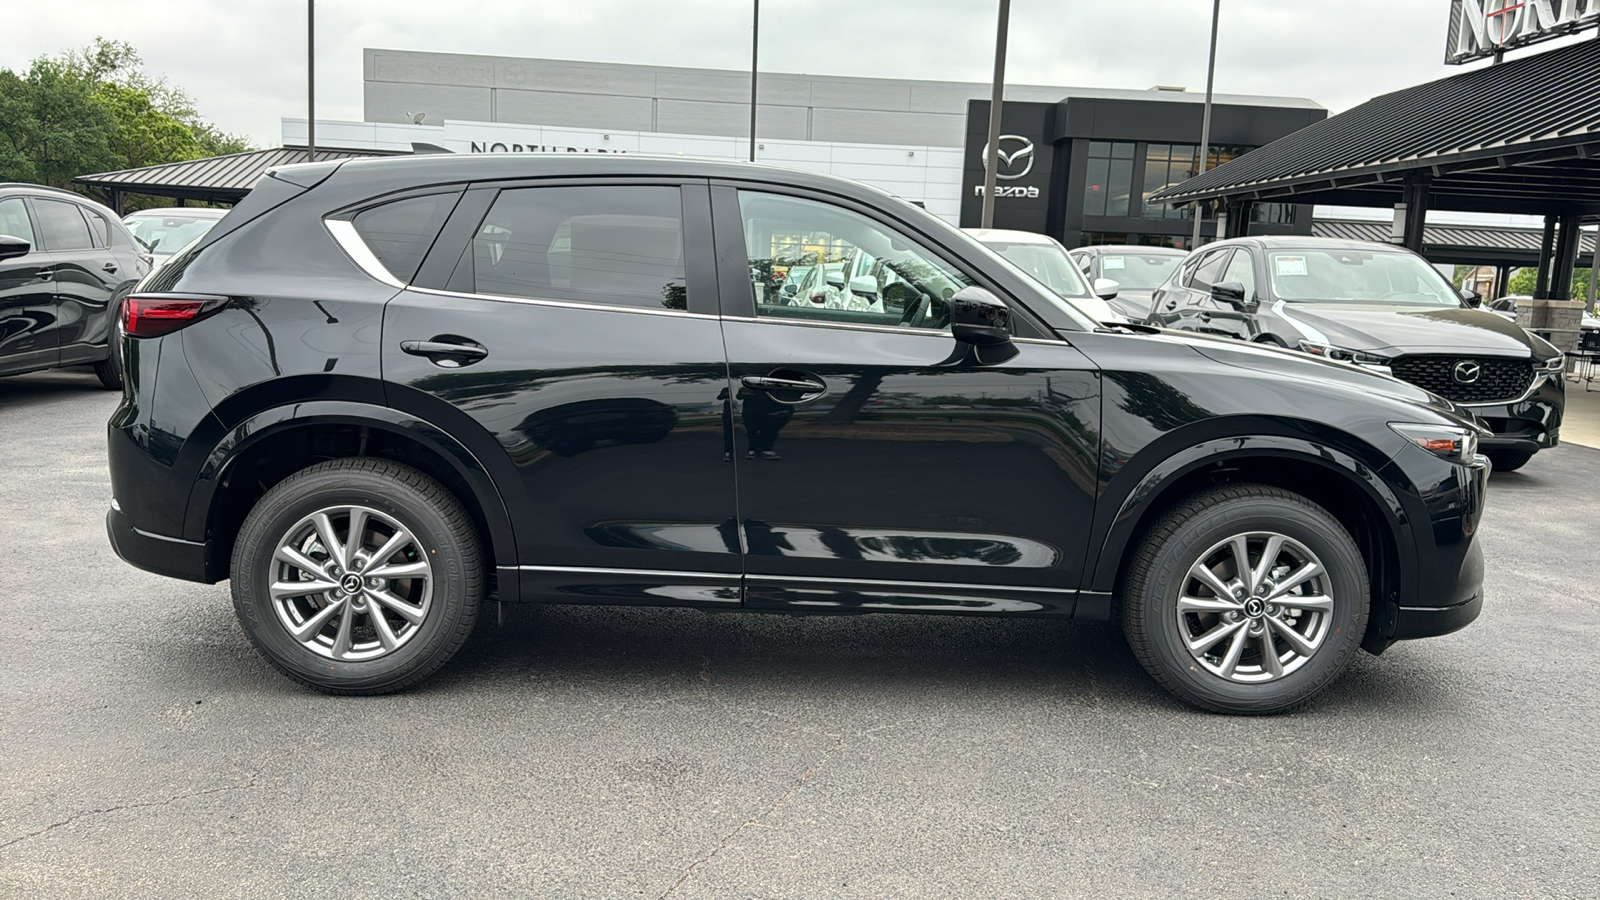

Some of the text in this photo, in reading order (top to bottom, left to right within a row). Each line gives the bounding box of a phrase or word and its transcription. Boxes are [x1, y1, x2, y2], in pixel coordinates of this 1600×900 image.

[1453, 0, 1600, 57] NOR
[239, 515, 271, 630] YOKOHAMA
[418, 529, 461, 660] GEOLANDAR
